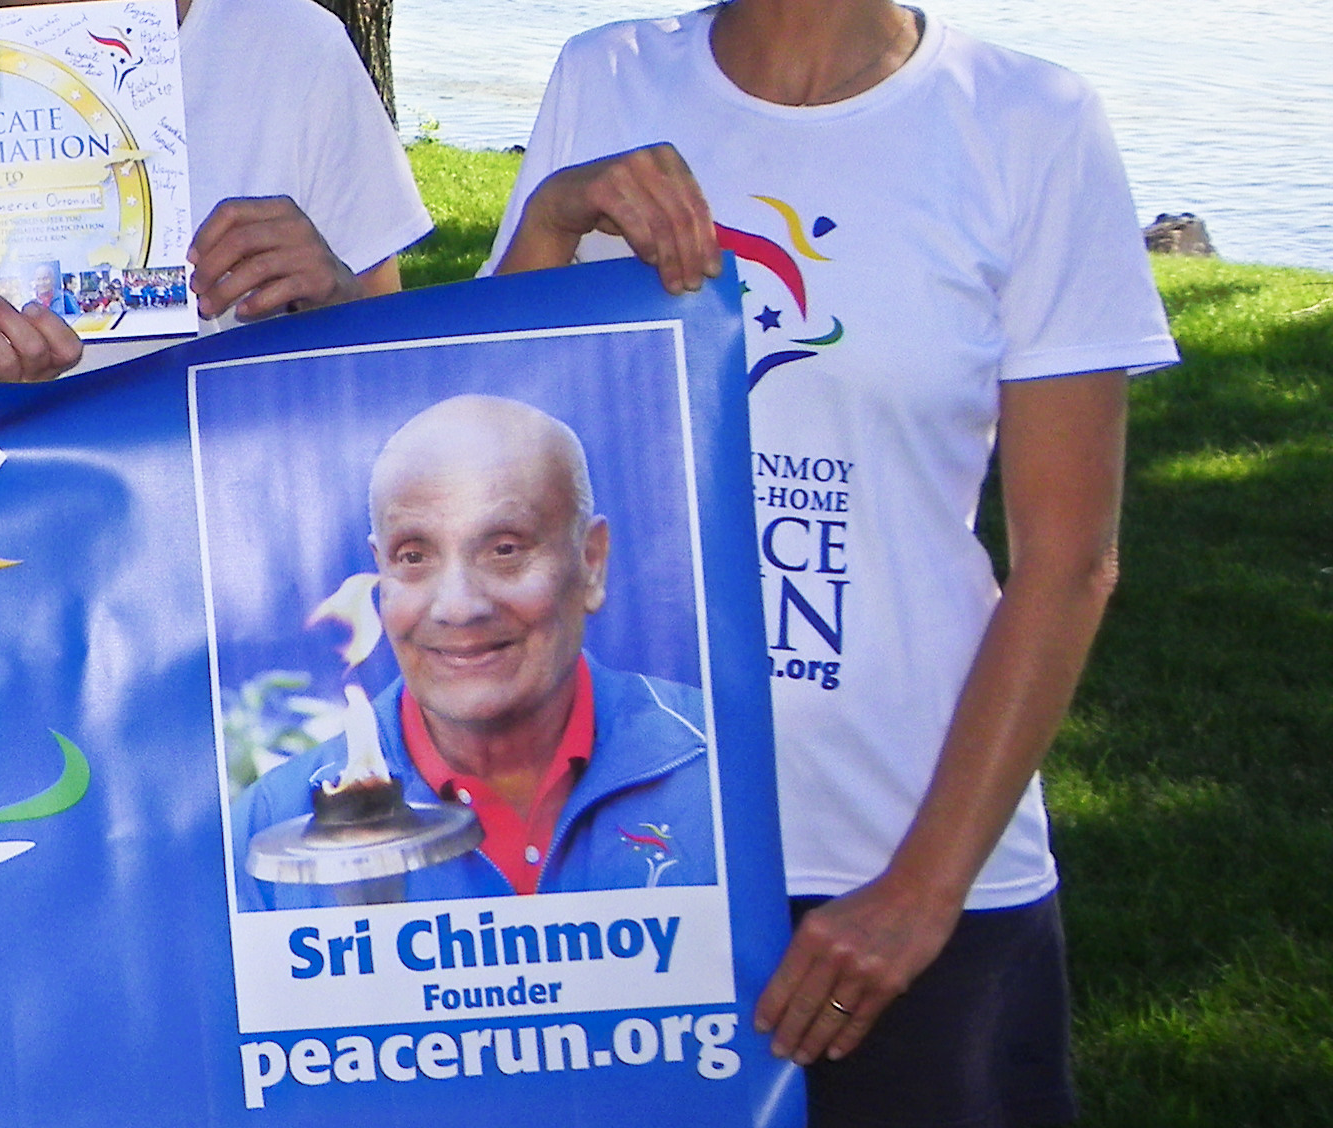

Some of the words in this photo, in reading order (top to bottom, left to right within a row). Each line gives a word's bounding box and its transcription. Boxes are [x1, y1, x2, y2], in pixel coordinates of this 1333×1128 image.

[5, 171, 24, 183] TO
[752, 452, 854, 484] NMOY
[753, 484, 849, 512] -HOME
[762, 516, 848, 574] CE
[769, 575, 851, 655] N
[288, 918, 374, 979] Sri
[395, 910, 680, 973] Chinmoy
[422, 976, 563, 1011] Founder
[239, 1011, 741, 1109] peacerun.org
